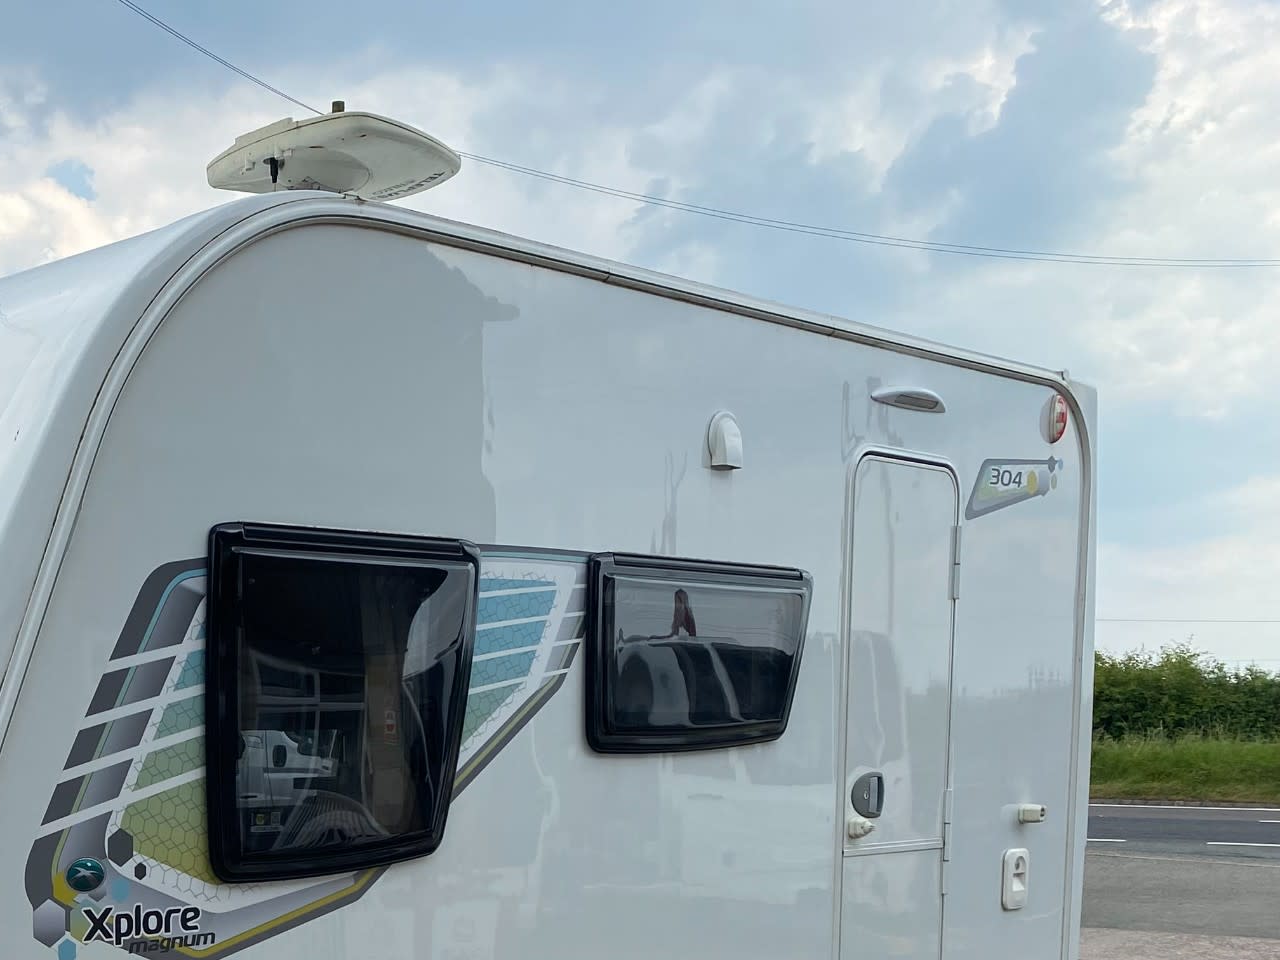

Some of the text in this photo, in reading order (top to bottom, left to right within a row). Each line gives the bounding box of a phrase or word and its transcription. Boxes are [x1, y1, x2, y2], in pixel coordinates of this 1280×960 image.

[990, 467, 1023, 489] 304
[82, 903, 201, 946] Xplore
[128, 931, 216, 955] magnum
